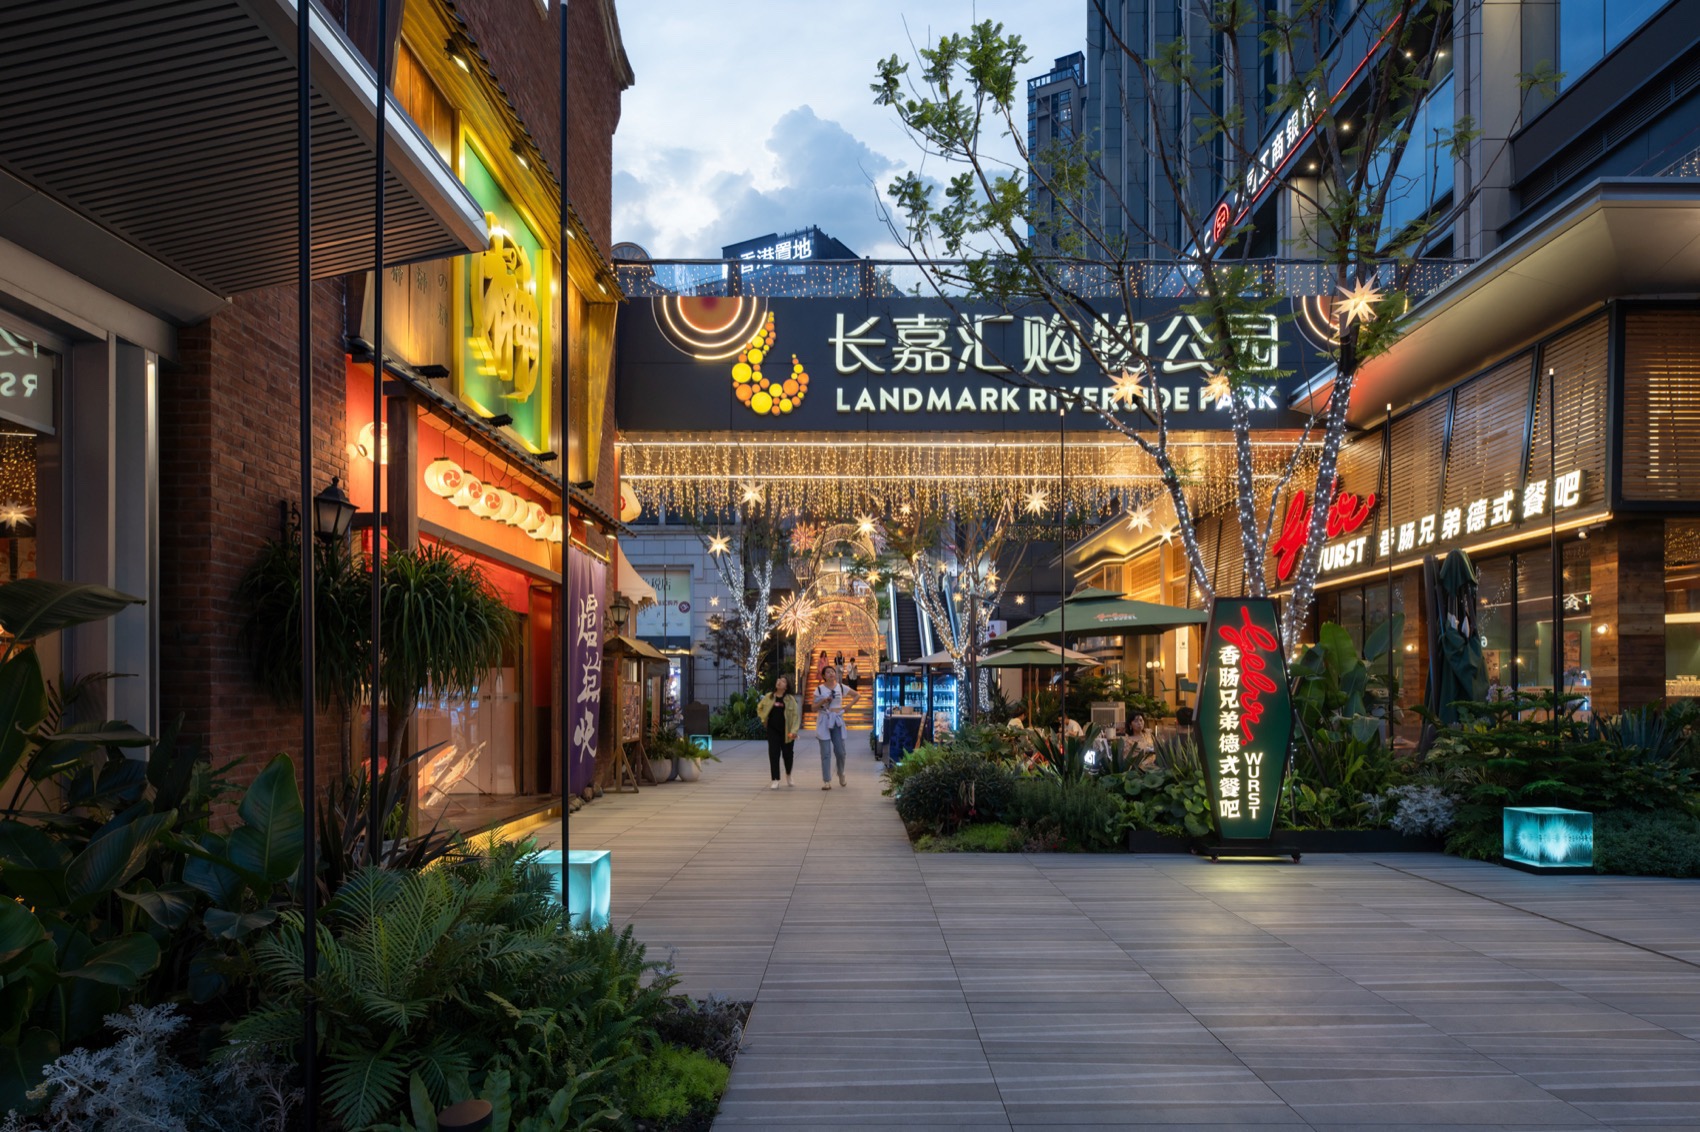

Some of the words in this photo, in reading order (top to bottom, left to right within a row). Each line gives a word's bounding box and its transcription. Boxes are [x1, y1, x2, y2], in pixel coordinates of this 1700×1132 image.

[836, 386, 1020, 412] LANDMARK
[1379, 469, 1581, 557] 香肠兄弟德式餐吧
[1218, 645, 1241, 819] 香肠兄弟德式餐吧
[1244, 752, 1263, 819] WURST
